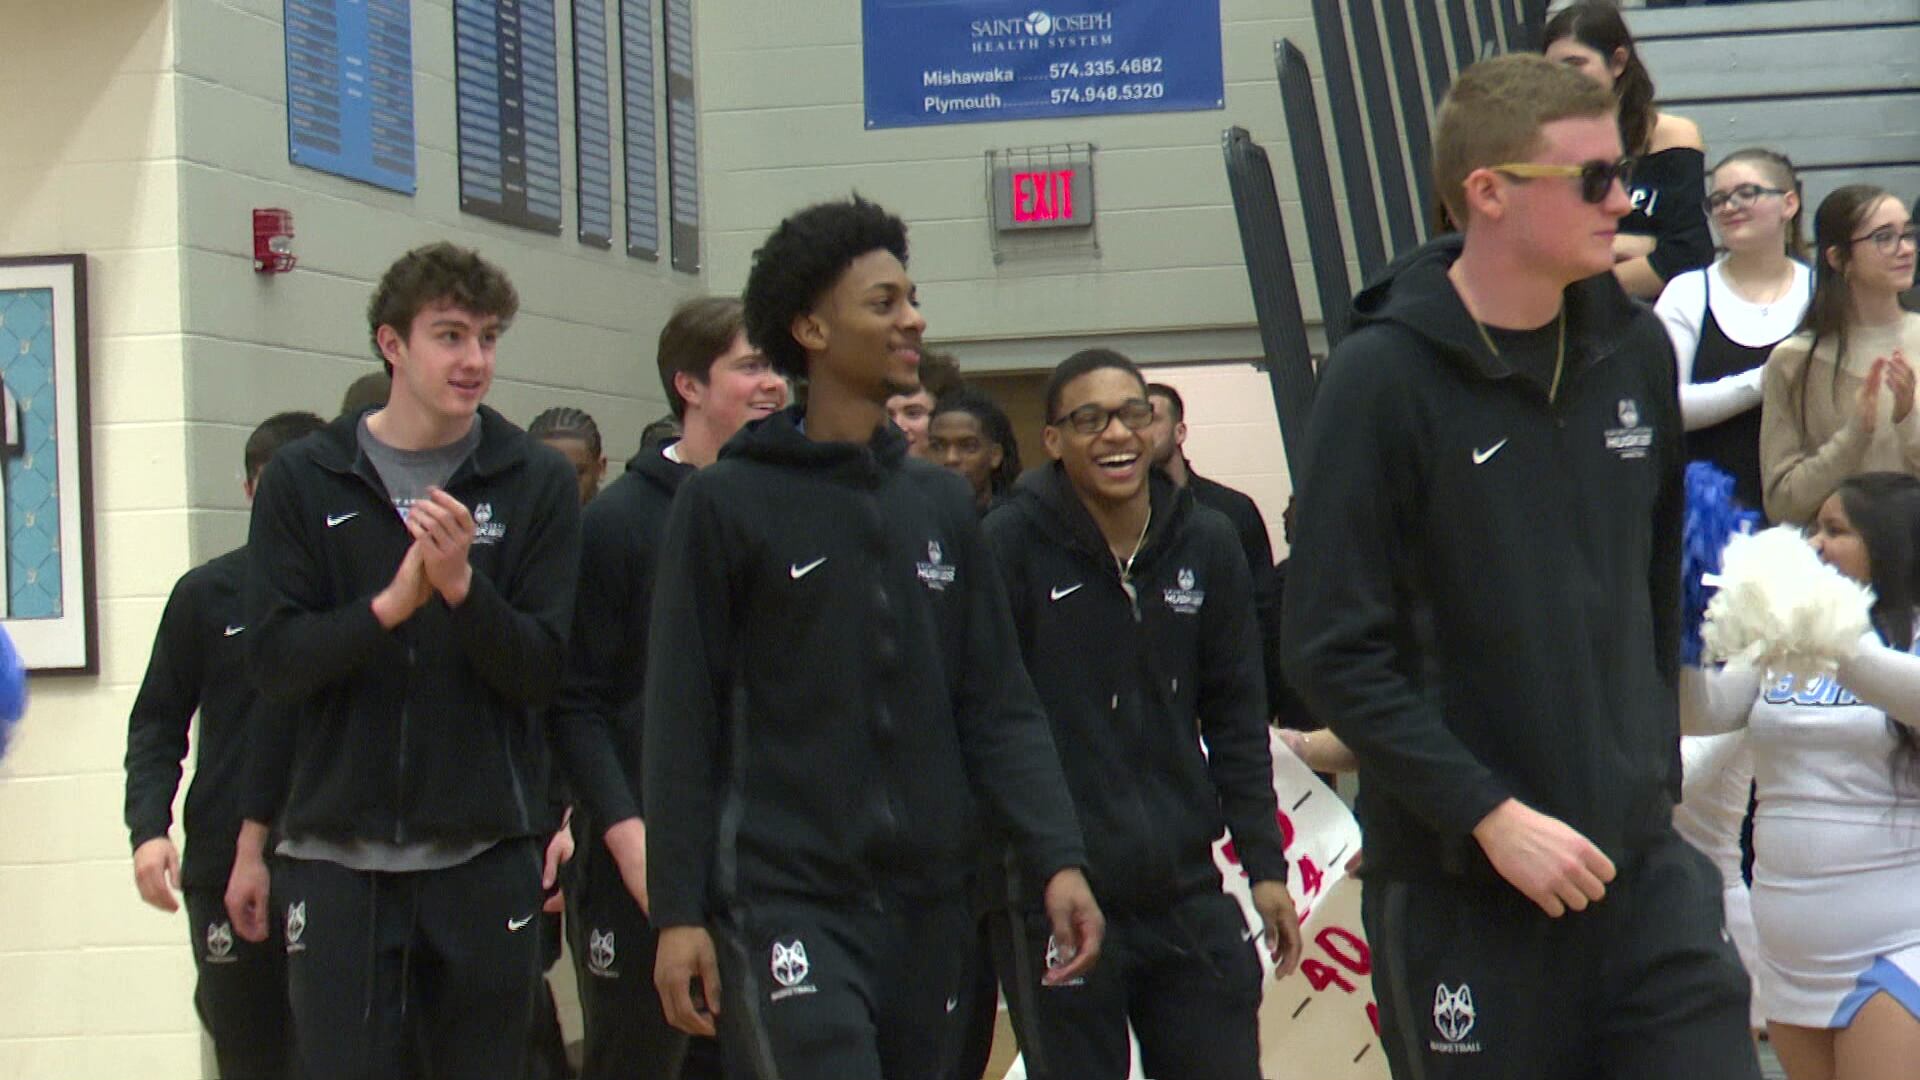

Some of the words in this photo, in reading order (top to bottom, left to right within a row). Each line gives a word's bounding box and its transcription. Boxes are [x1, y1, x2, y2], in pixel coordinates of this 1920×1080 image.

[971, 18, 1022, 37] SAINT
[1050, 12, 1112, 36] JOSEPH
[972, 39, 1039, 53] HEALTH
[1048, 34, 1112, 48] SYSTEM
[923, 68, 1014, 87] Mishawaka
[924, 95, 1001, 114] Plymouth
[1050, 83, 1164, 104] 574.948.5320
[1014, 169, 1076, 223] EXIT
